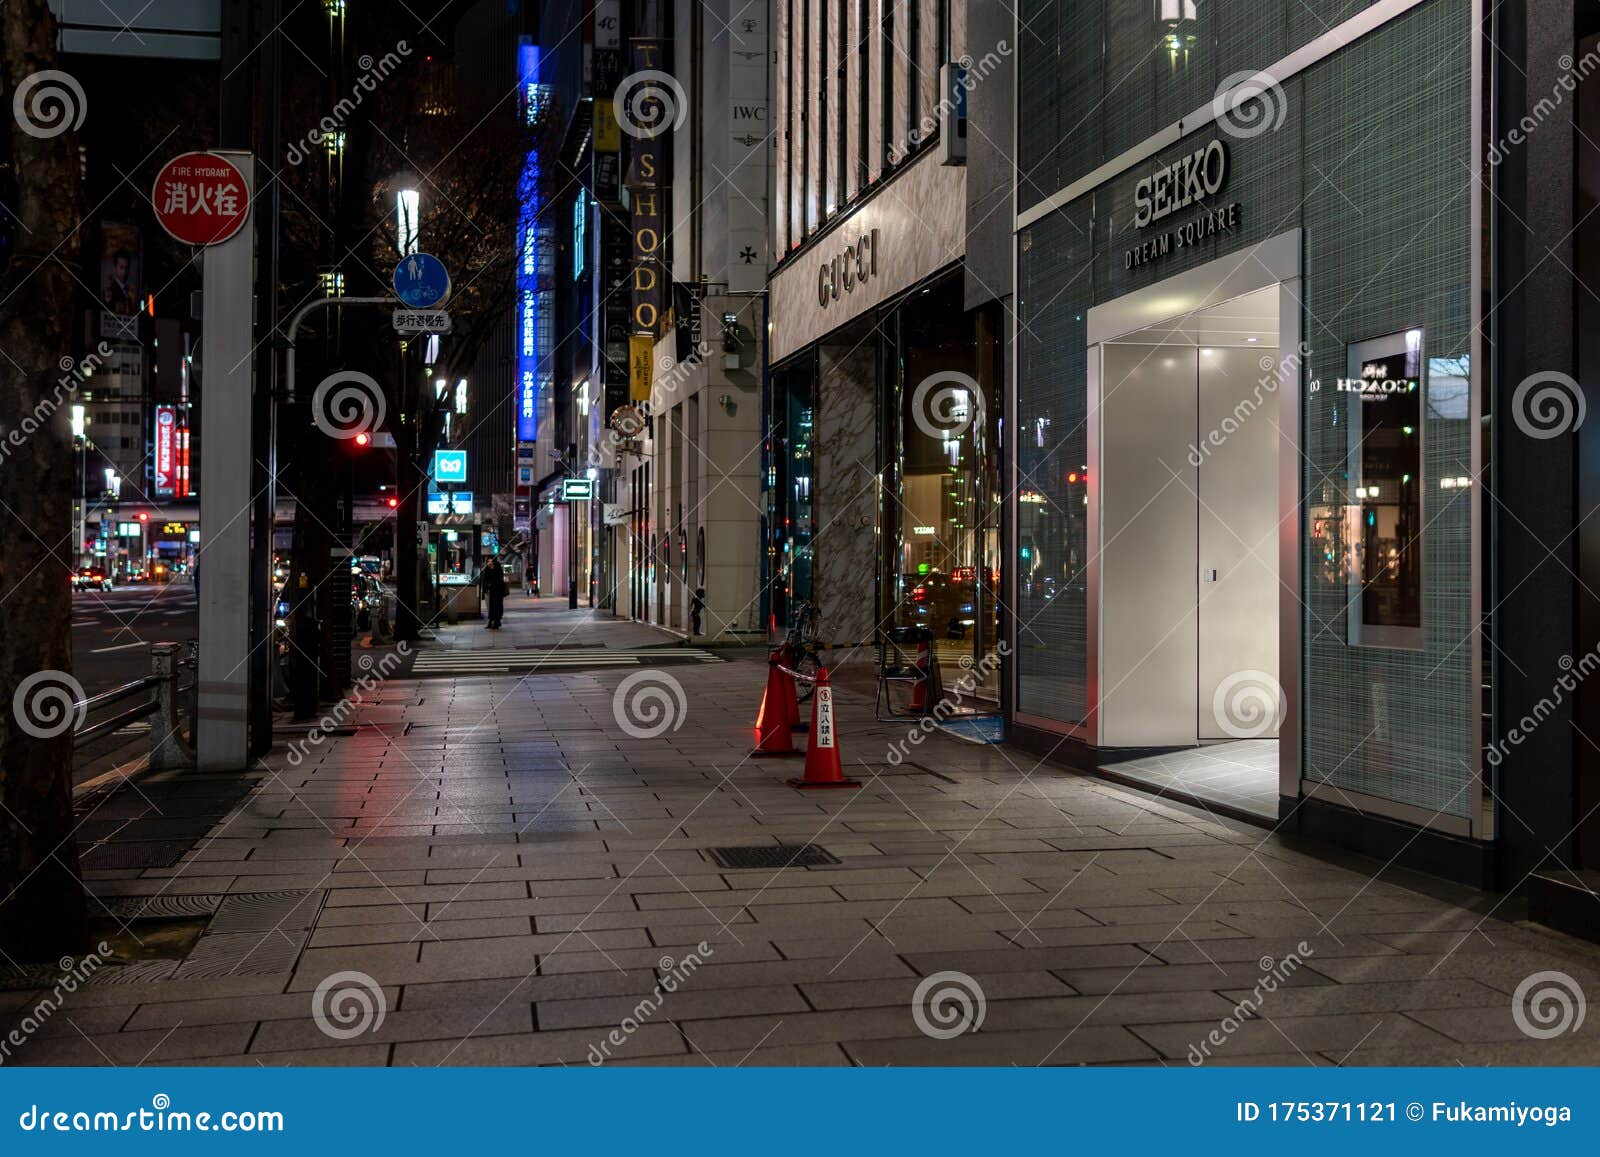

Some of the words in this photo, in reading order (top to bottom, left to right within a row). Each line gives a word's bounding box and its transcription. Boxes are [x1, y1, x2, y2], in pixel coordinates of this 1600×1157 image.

[733, 106, 766, 121] IWC
[172, 167, 191, 176] FIRE
[195, 168, 230, 177] HYDRANT
[635, 45, 658, 327] TENSHODO
[1134, 139, 1225, 229] SEIKO
[163, 182, 239, 216] 消火栓
[1125, 233, 1169, 270] DREAM
[1177, 204, 1236, 248] SQUARE
[818, 228, 878, 307] GUCCI
[396, 314, 445, 327] 歩行者優先
[690, 288, 701, 355] ZENITH
[820, 704, 830, 745] 立入禁止
